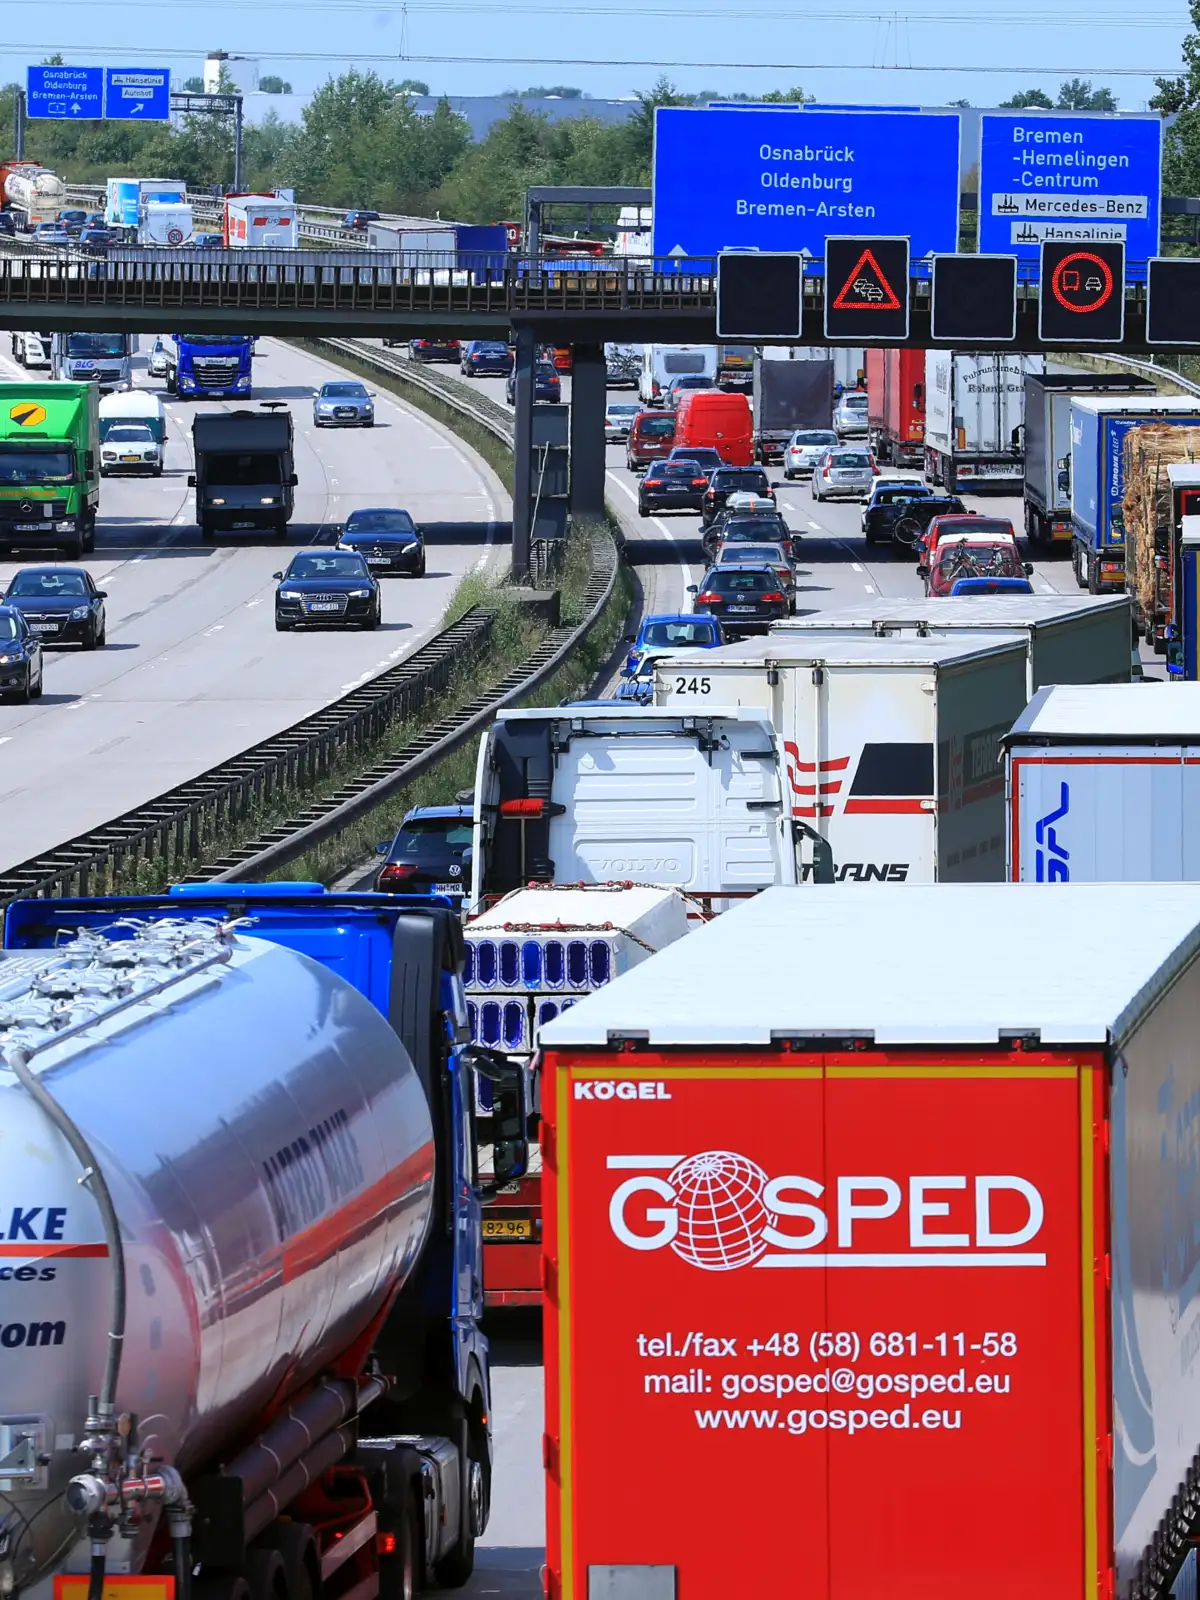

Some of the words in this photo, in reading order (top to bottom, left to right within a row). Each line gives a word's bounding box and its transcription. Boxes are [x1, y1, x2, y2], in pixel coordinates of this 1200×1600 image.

[1013, 127, 1083, 144] Bremen
[759, 144, 855, 162] Osnabrück
[1012, 150, 1129, 170] -Hemelingen
[761, 172, 852, 193] Oldenburg
[1012, 171, 1099, 188] -Centrum
[736, 200, 876, 217] Bremen-Arsten
[1025, 198, 1143, 214] Mercedes-Benz
[75, 360, 95, 369] BLG
[675, 677, 711, 695] 245
[588, 858, 681, 874] VOLVO
[574, 1081, 672, 1100] KÖGEL
[608, 1151, 1045, 1271] GOSPED
[0, 1207, 68, 1240] KE
[0, 1320, 66, 1348] om
[636, 1332, 737, 1357] tel./fax
[746, 1332, 800, 1357] +48
[809, 1332, 861, 1362] (58)
[869, 1332, 1018, 1357] 681-11-58
[643, 1368, 712, 1393] mail:
[721, 1368, 1011, 1399] gosped@gosped.eu
[694, 1404, 962, 1435] www.gosped.eu
